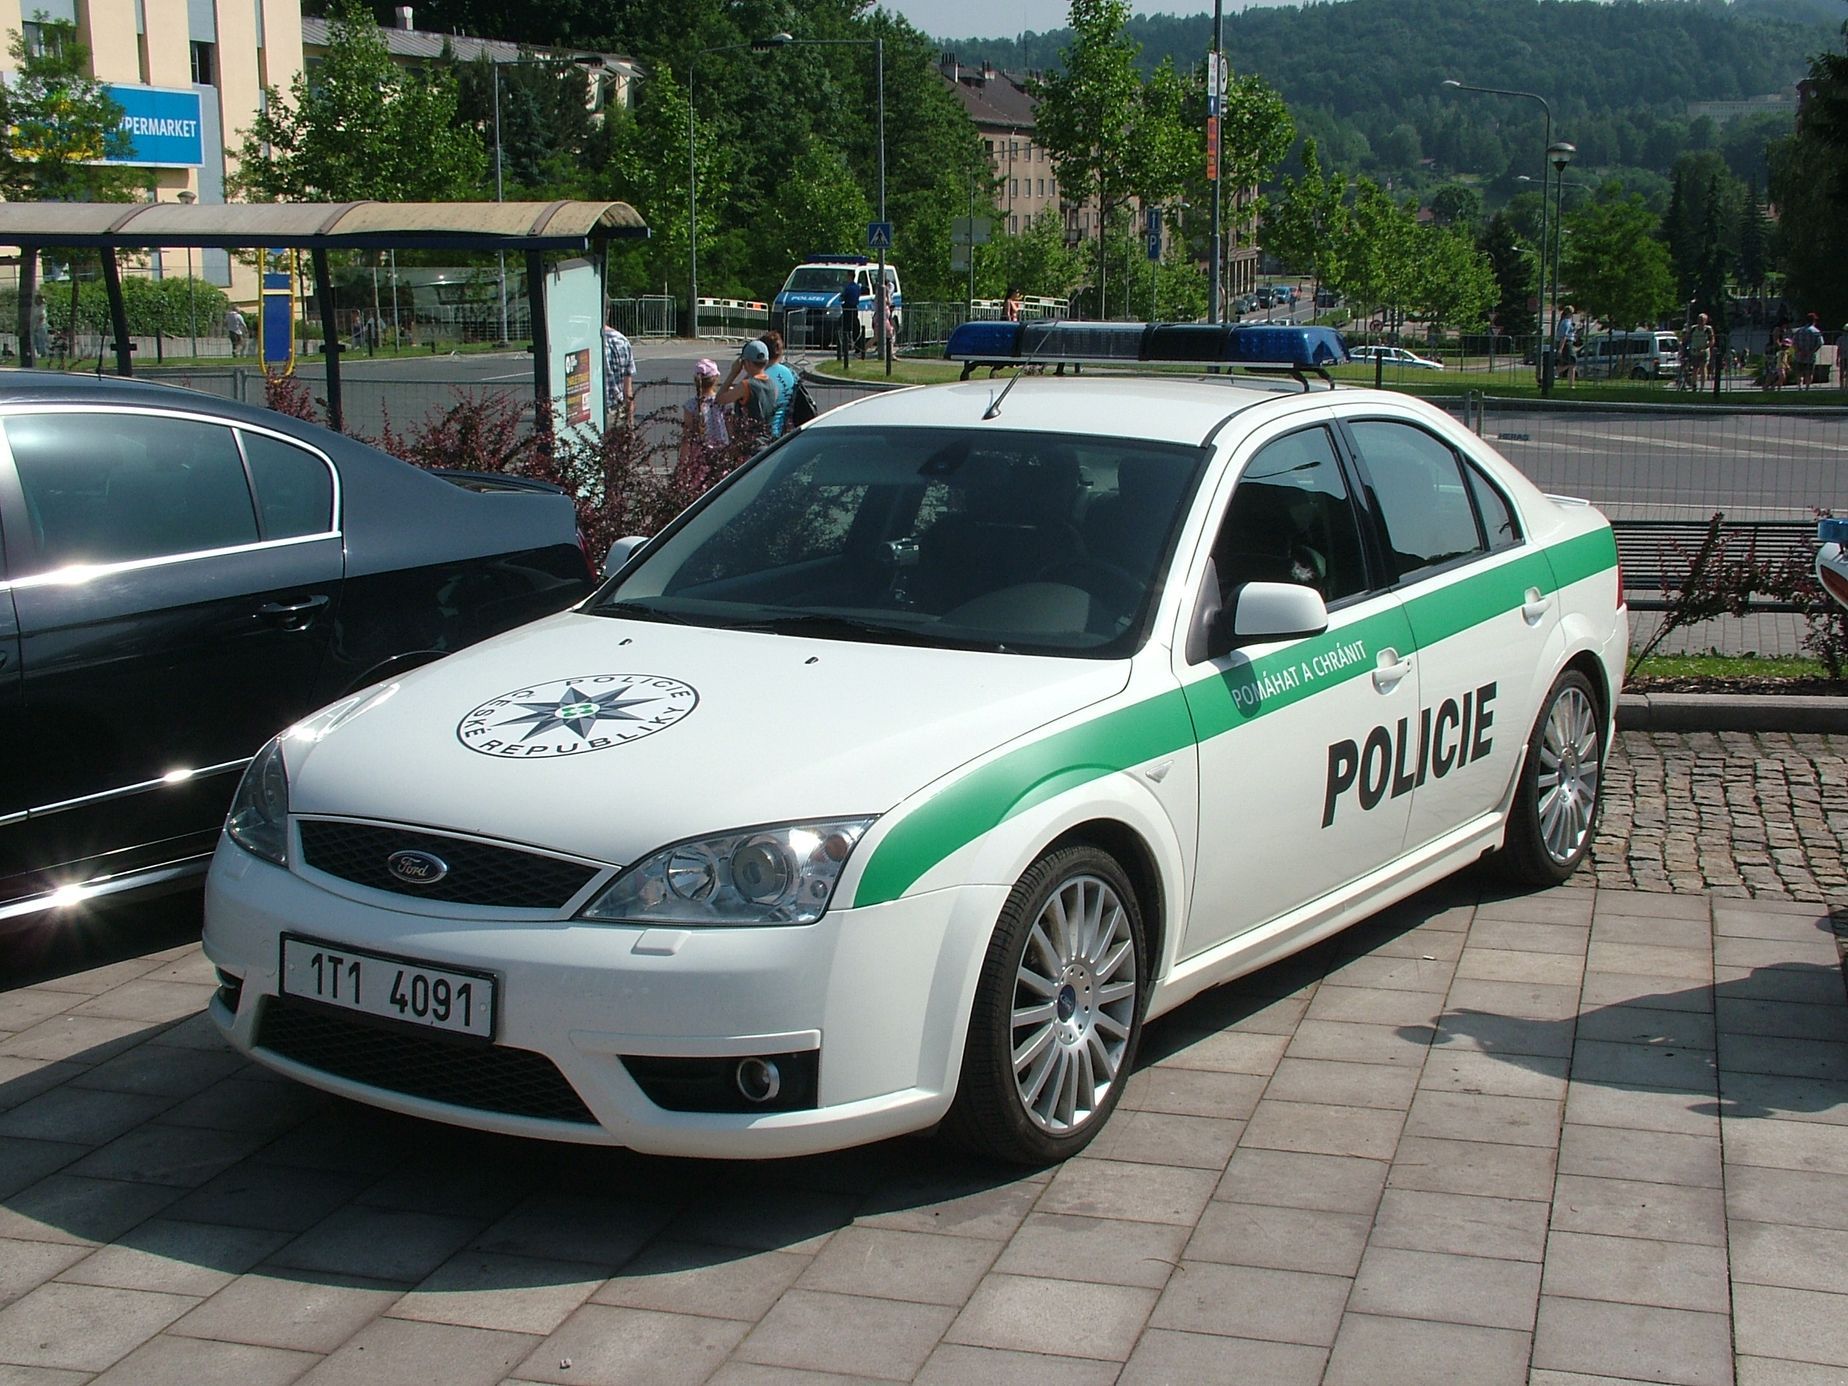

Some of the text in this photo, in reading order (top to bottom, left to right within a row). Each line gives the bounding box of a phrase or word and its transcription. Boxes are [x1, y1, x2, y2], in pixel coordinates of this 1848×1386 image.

[565, 676, 692, 698] POLICIE
[1231, 640, 1367, 709] POMÁHAT A CHRÁNIT
[478, 706, 686, 756] REPUBLIKY
[1321, 681, 1497, 829] POLICIE
[397, 856, 430, 878] Ford
[311, 953, 472, 1027] 1T1 4091
